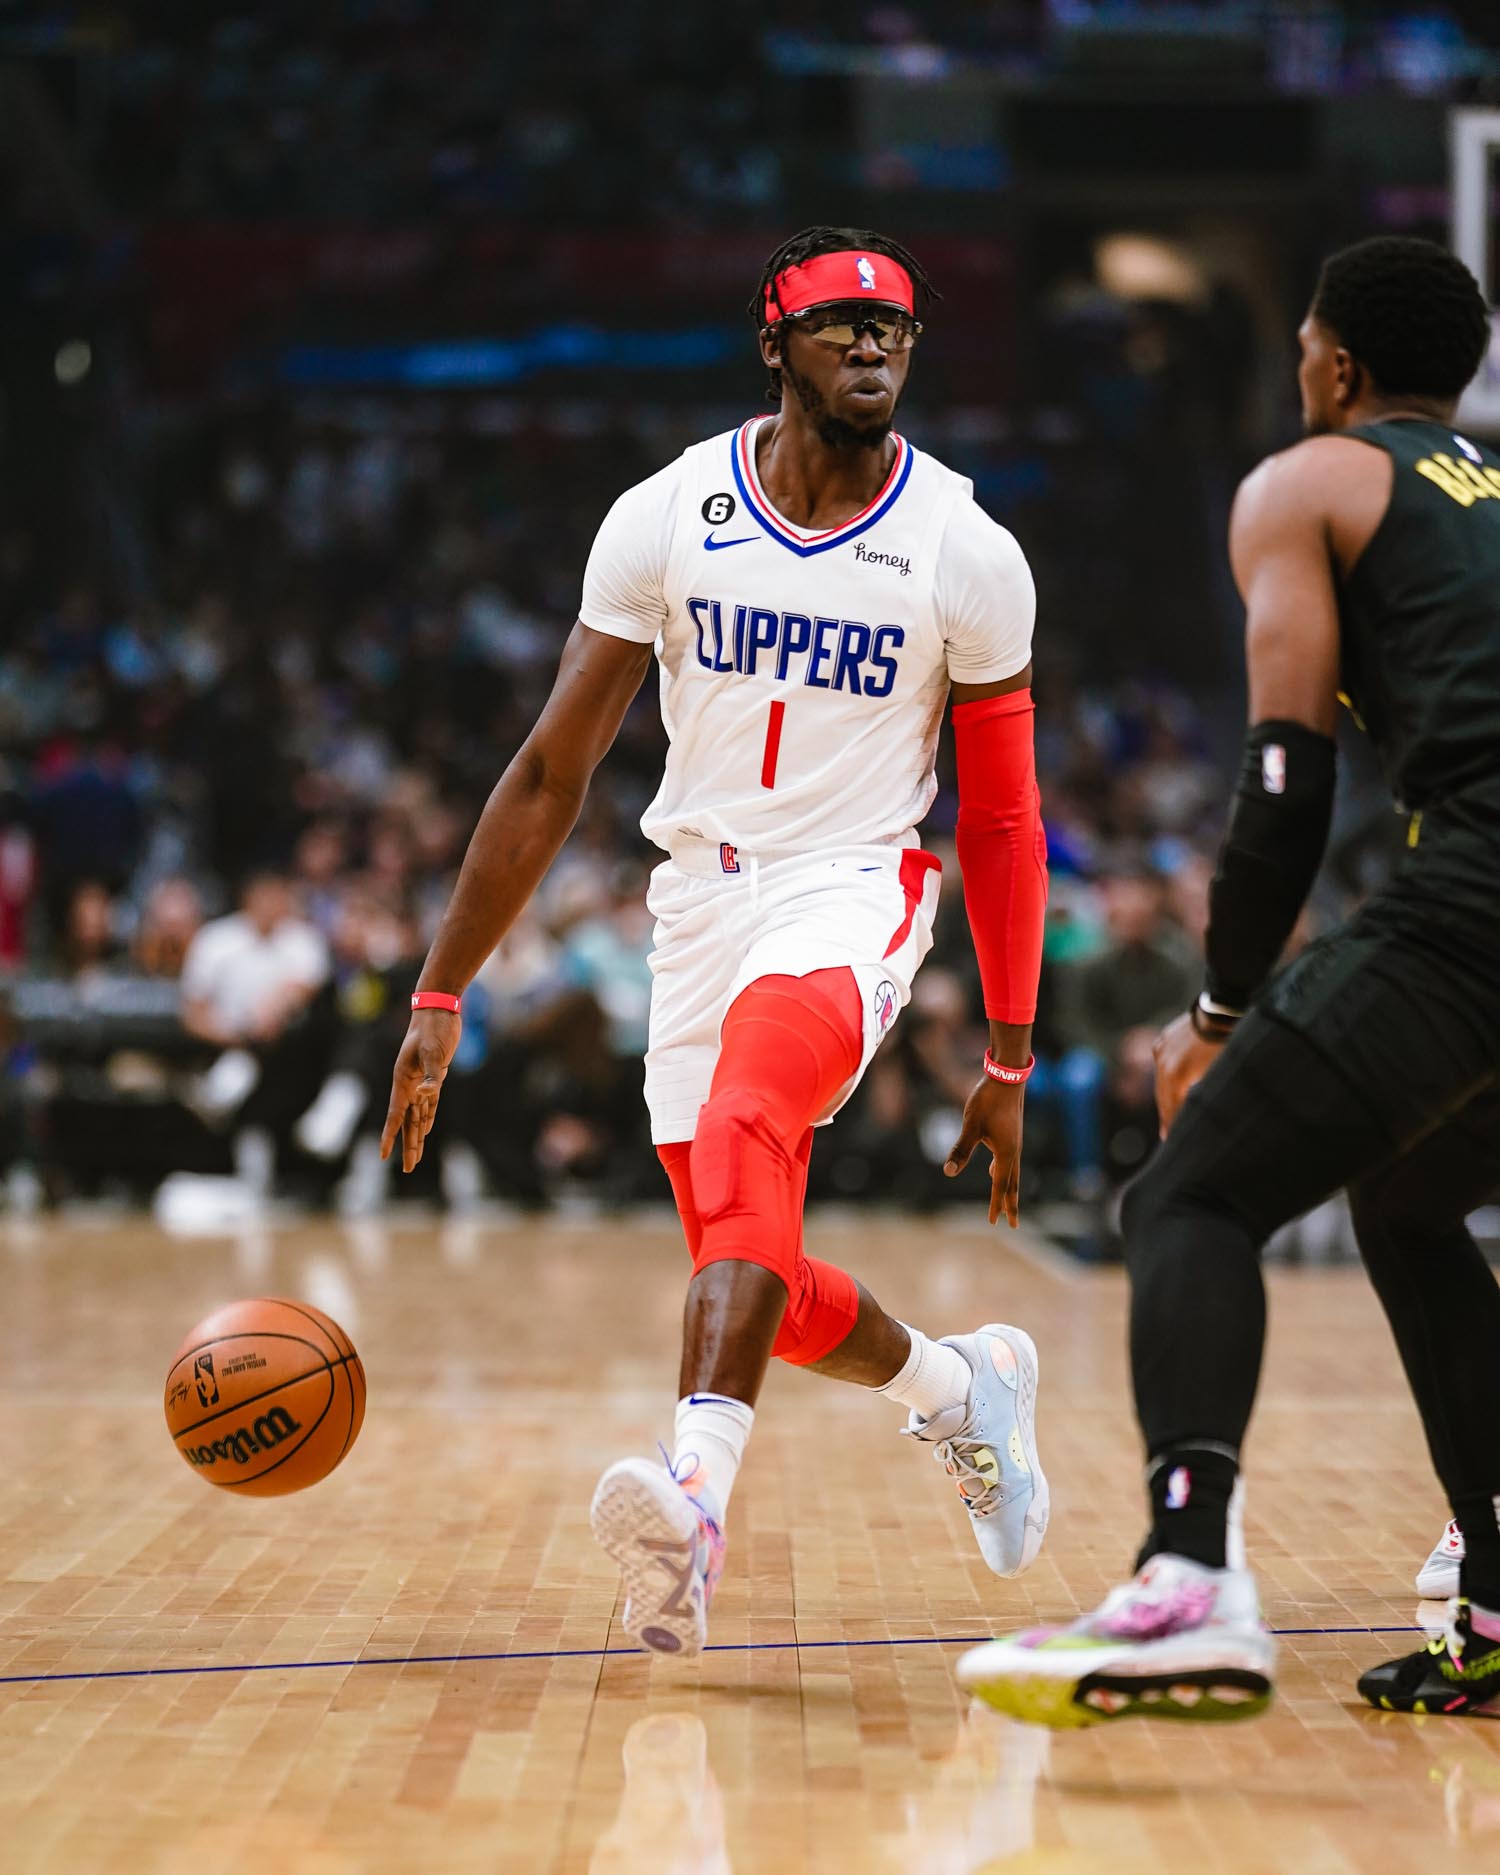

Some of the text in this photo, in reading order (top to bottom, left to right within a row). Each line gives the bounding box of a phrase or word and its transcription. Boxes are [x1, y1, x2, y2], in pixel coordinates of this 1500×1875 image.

[1414, 450, 1500, 508] BEA
[706, 496, 731, 522] 6
[853, 542, 912, 577] honey
[686, 597, 904, 698] CLIPPERS
[761, 700, 785, 789] 1
[987, 1063, 1023, 1081] HENRY
[183, 1405, 302, 1466] Wilson
